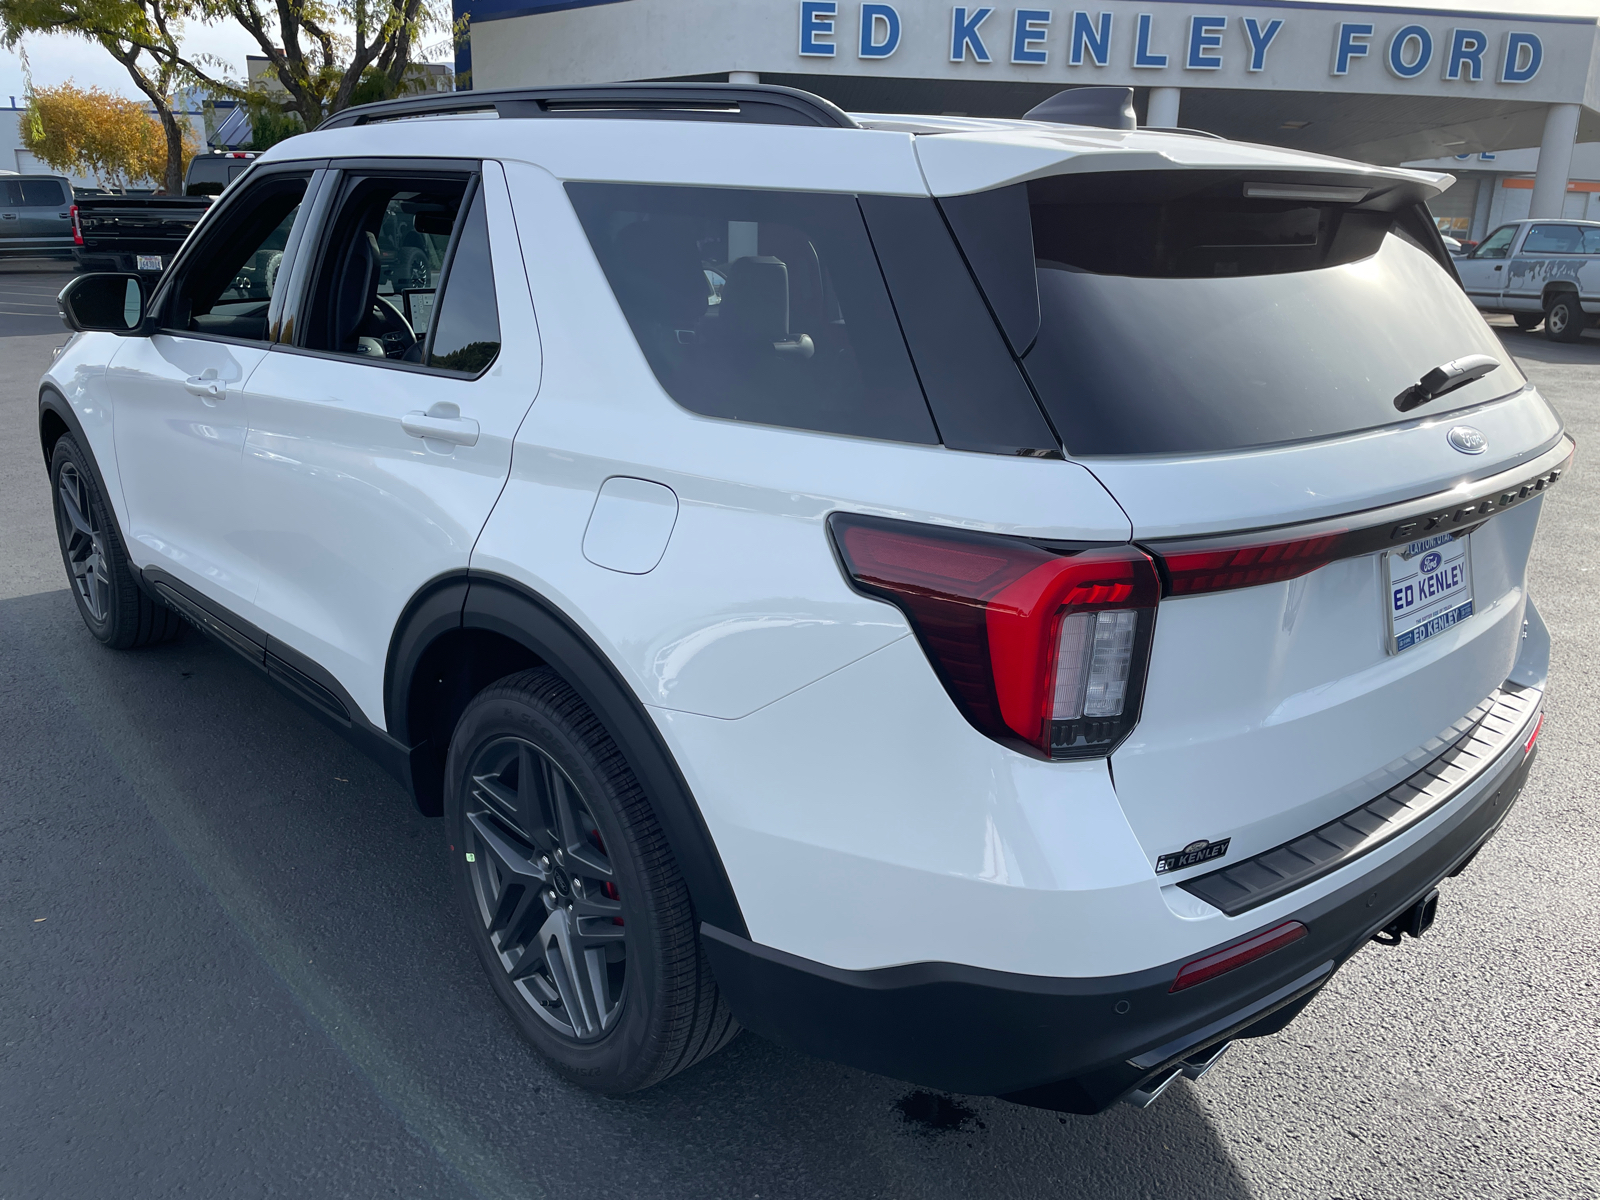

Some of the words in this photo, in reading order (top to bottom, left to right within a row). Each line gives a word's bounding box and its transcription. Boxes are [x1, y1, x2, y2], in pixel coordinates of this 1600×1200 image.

[799, 1, 902, 59] ED
[949, 6, 1286, 72] KENLEY
[1330, 22, 1544, 84] FORD
[1423, 555, 1439, 572] Ford
[1393, 584, 1414, 611] ED
[1418, 561, 1465, 601] KENLEY
[1413, 626, 1426, 644] ED
[1427, 609, 1460, 637] KENLEY
[1157, 858, 1175, 872] ED
[1179, 843, 1229, 866] KENLEY
